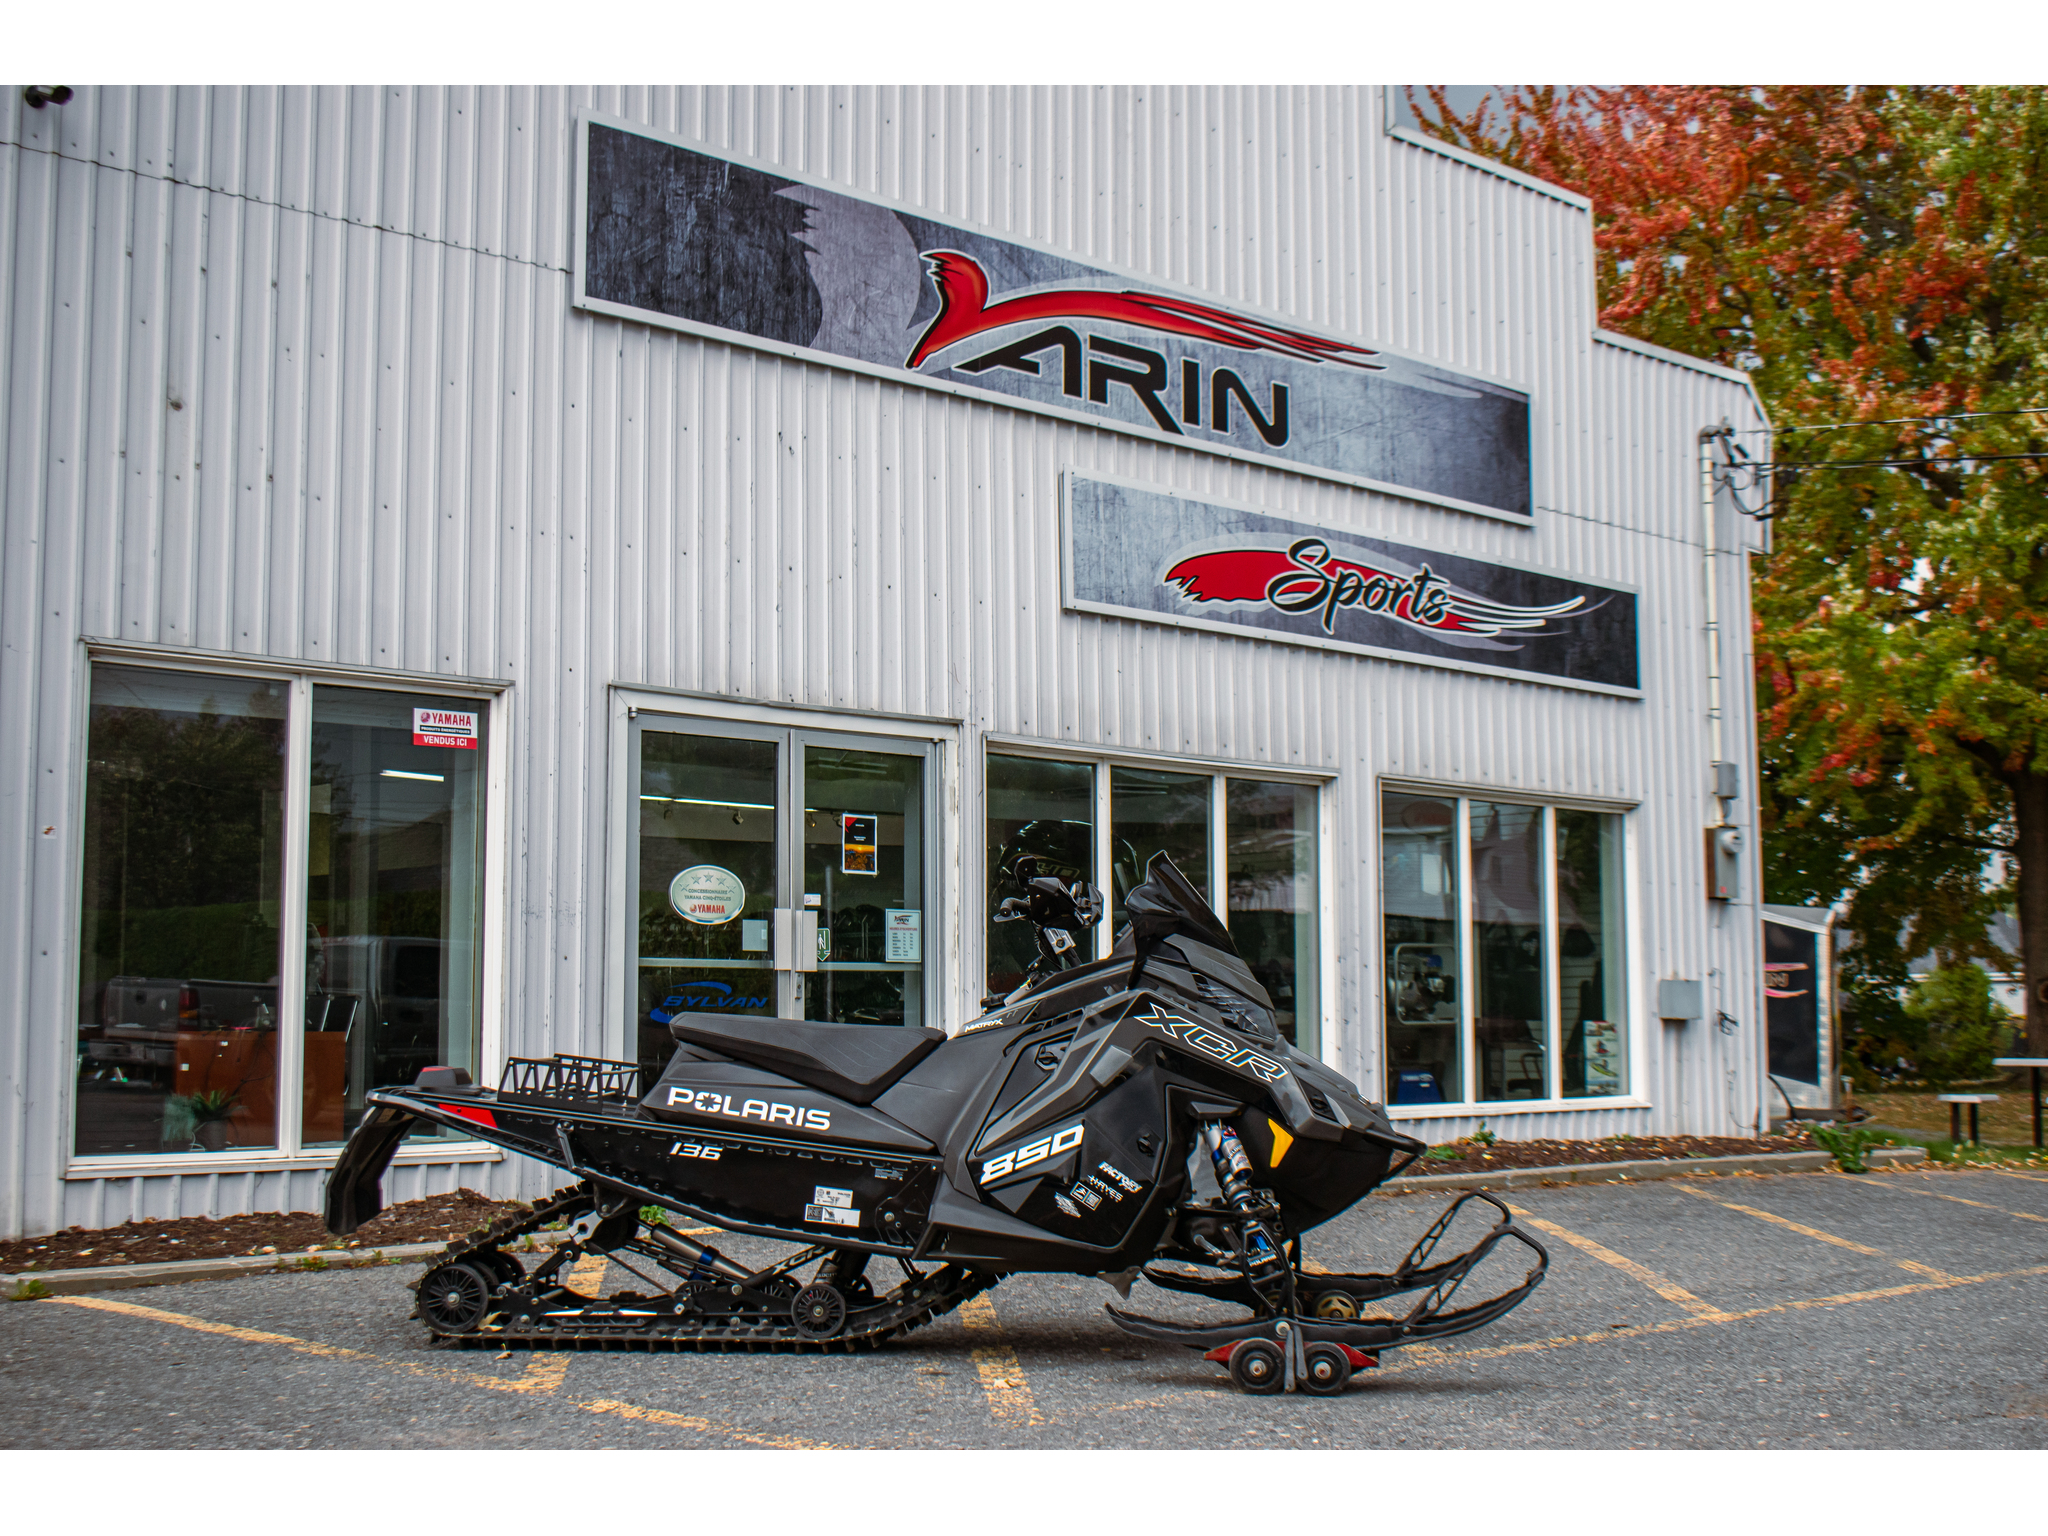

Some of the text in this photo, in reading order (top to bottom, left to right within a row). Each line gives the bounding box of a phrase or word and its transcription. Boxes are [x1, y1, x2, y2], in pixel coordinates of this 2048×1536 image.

[1267, 537, 1452, 635] Sports
[432, 712, 472, 727] YAMAHA
[423, 735, 468, 747] VENDUS ICI
[698, 904, 726, 914] YAMAHA
[663, 995, 769, 1009] SYLVAN
[964, 1018, 1004, 1033] MATRYX
[1134, 1002, 1289, 1083] XCR
[667, 1086, 831, 1131] POLARIS
[669, 1141, 723, 1161] 136
[980, 1123, 1085, 1185] 850
[1087, 1174, 1124, 1203] HAYES
[772, 1246, 826, 1276] XCR
